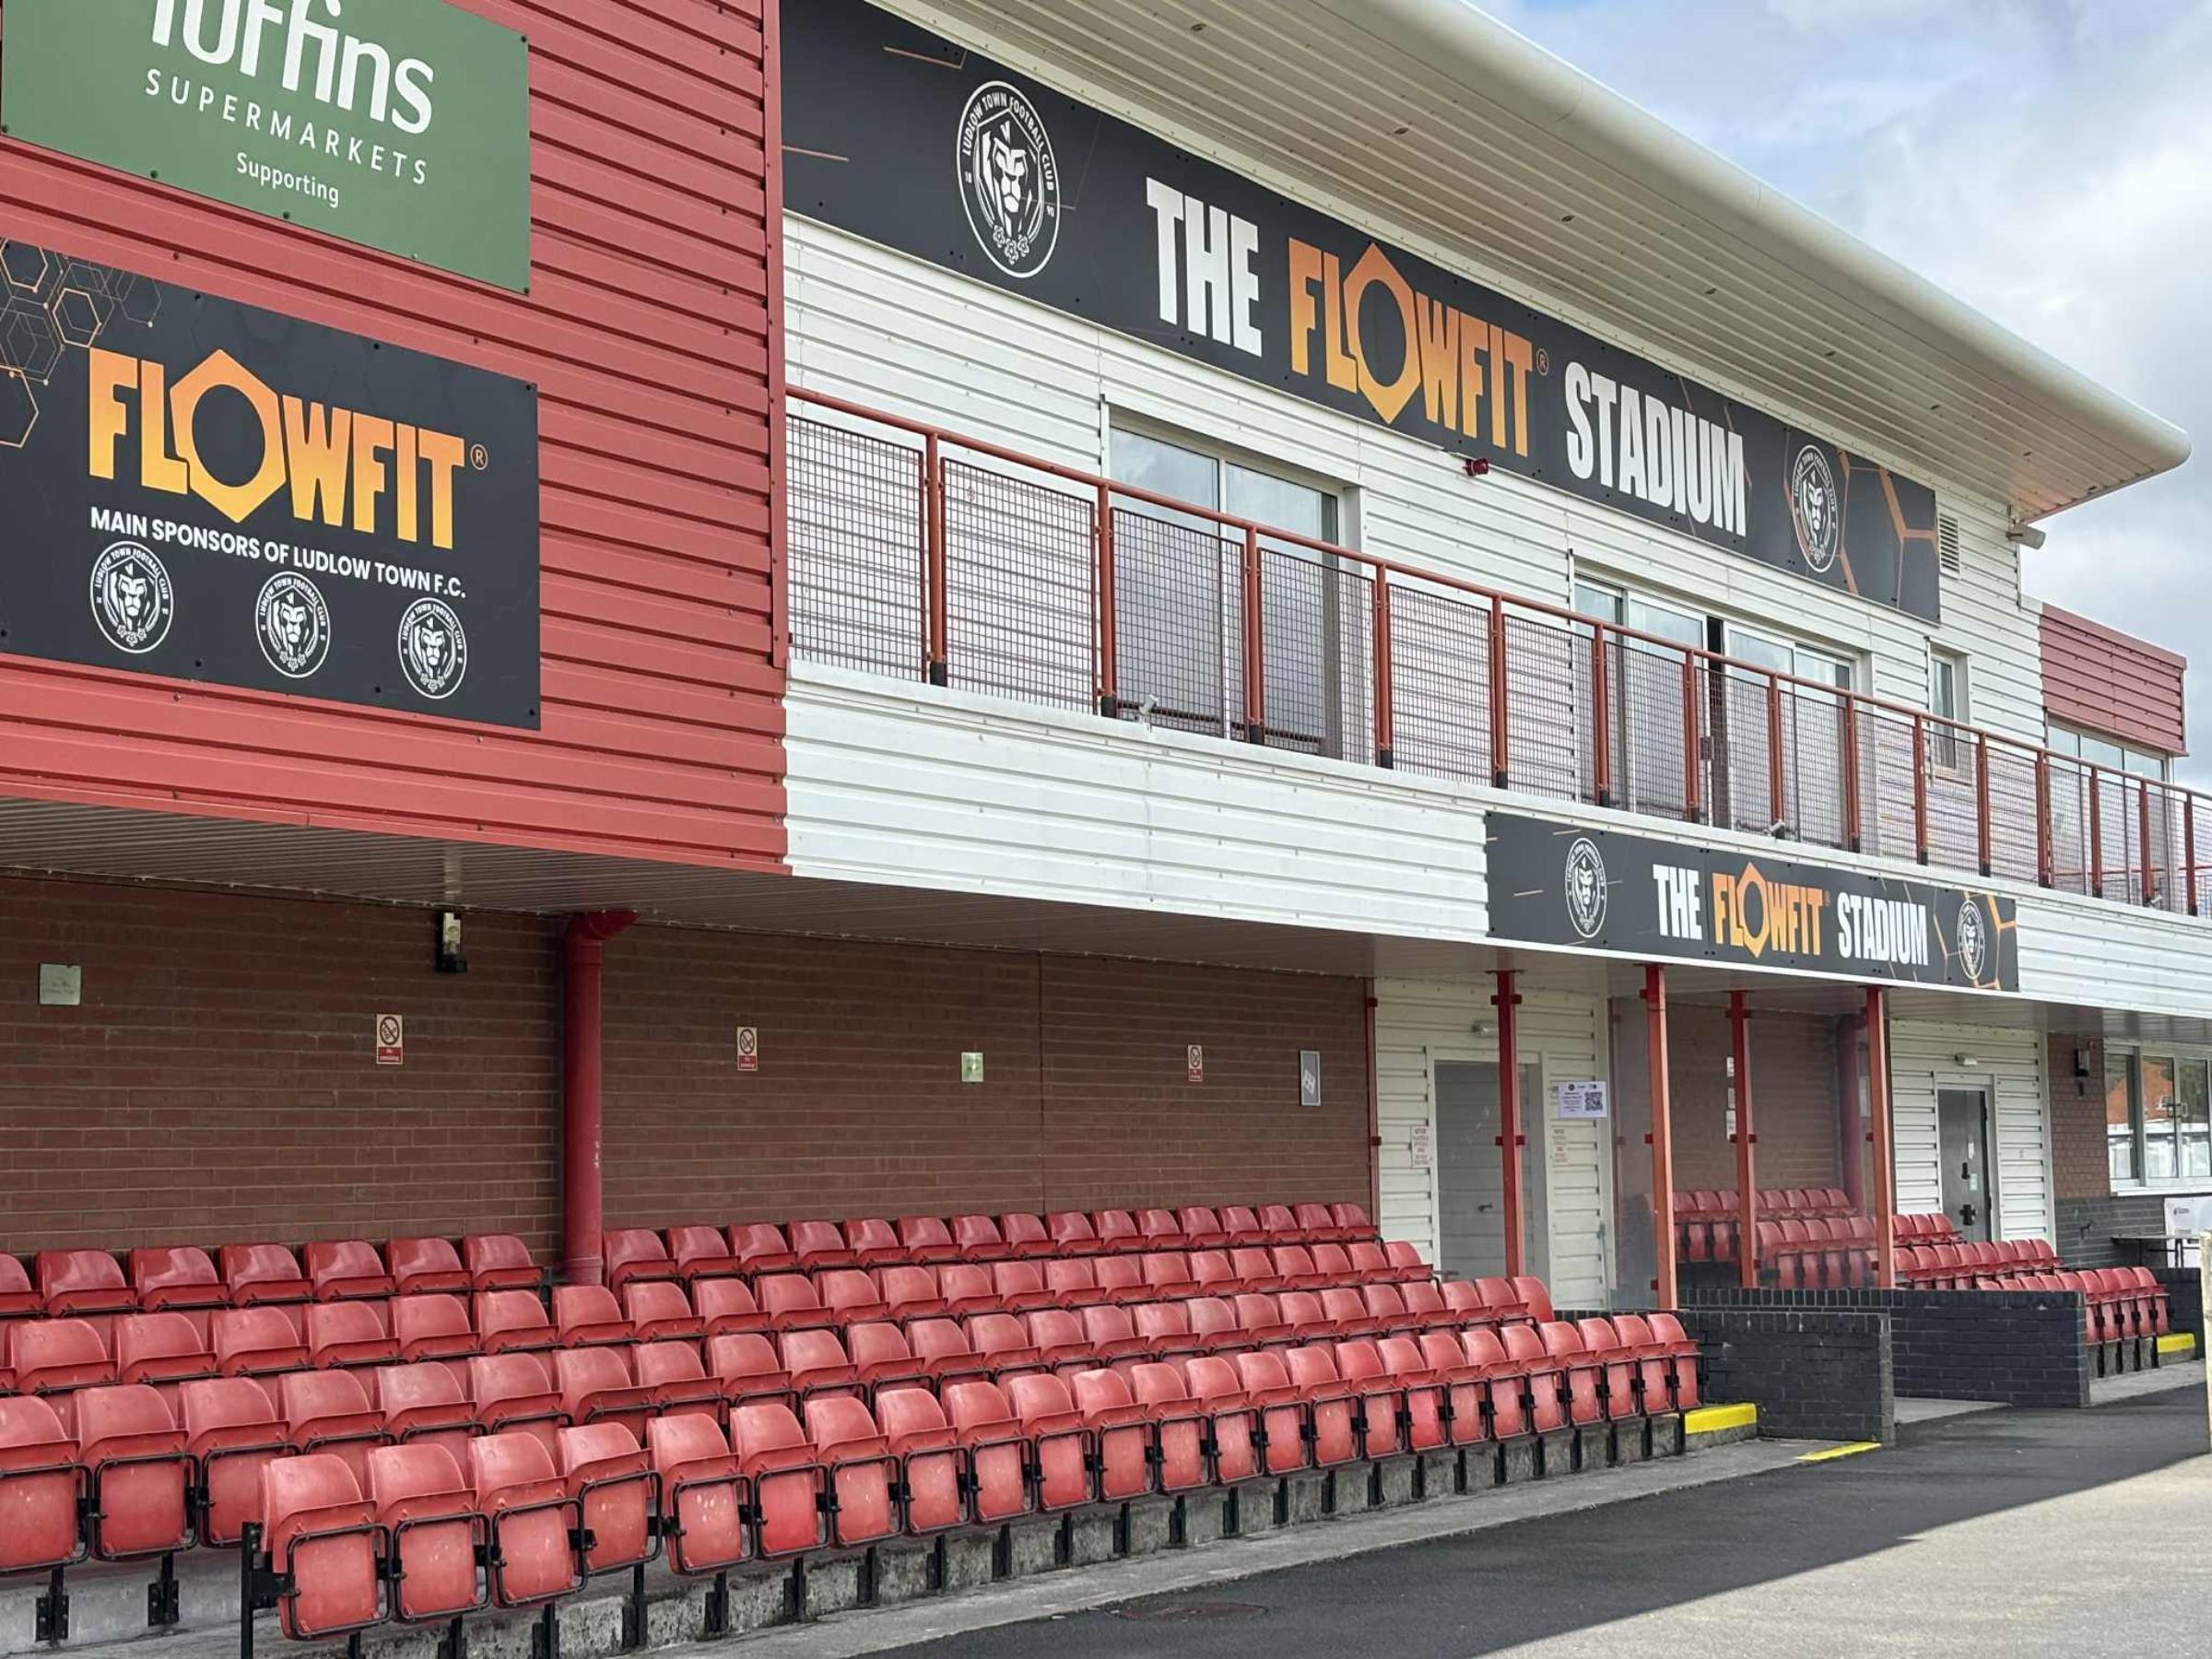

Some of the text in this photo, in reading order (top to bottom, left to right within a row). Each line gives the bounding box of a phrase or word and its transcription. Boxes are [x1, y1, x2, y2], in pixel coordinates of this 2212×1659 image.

[146, 68, 428, 184] SUPERMARKETS
[962, 92, 1054, 191] LUDLOW TOWN FOOTBALL CLUB
[236, 151, 339, 208] Supporting
[1146, 176, 1262, 358] THE
[1564, 361, 1747, 537] STADIUM
[90, 506, 466, 598] MAIN SPONSORS OF LUDLOW TOWN F.C.
[159, 578, 170, 600] CLUB
[1653, 864, 1702, 940] THE
[1837, 891, 1928, 966] STADIUM
